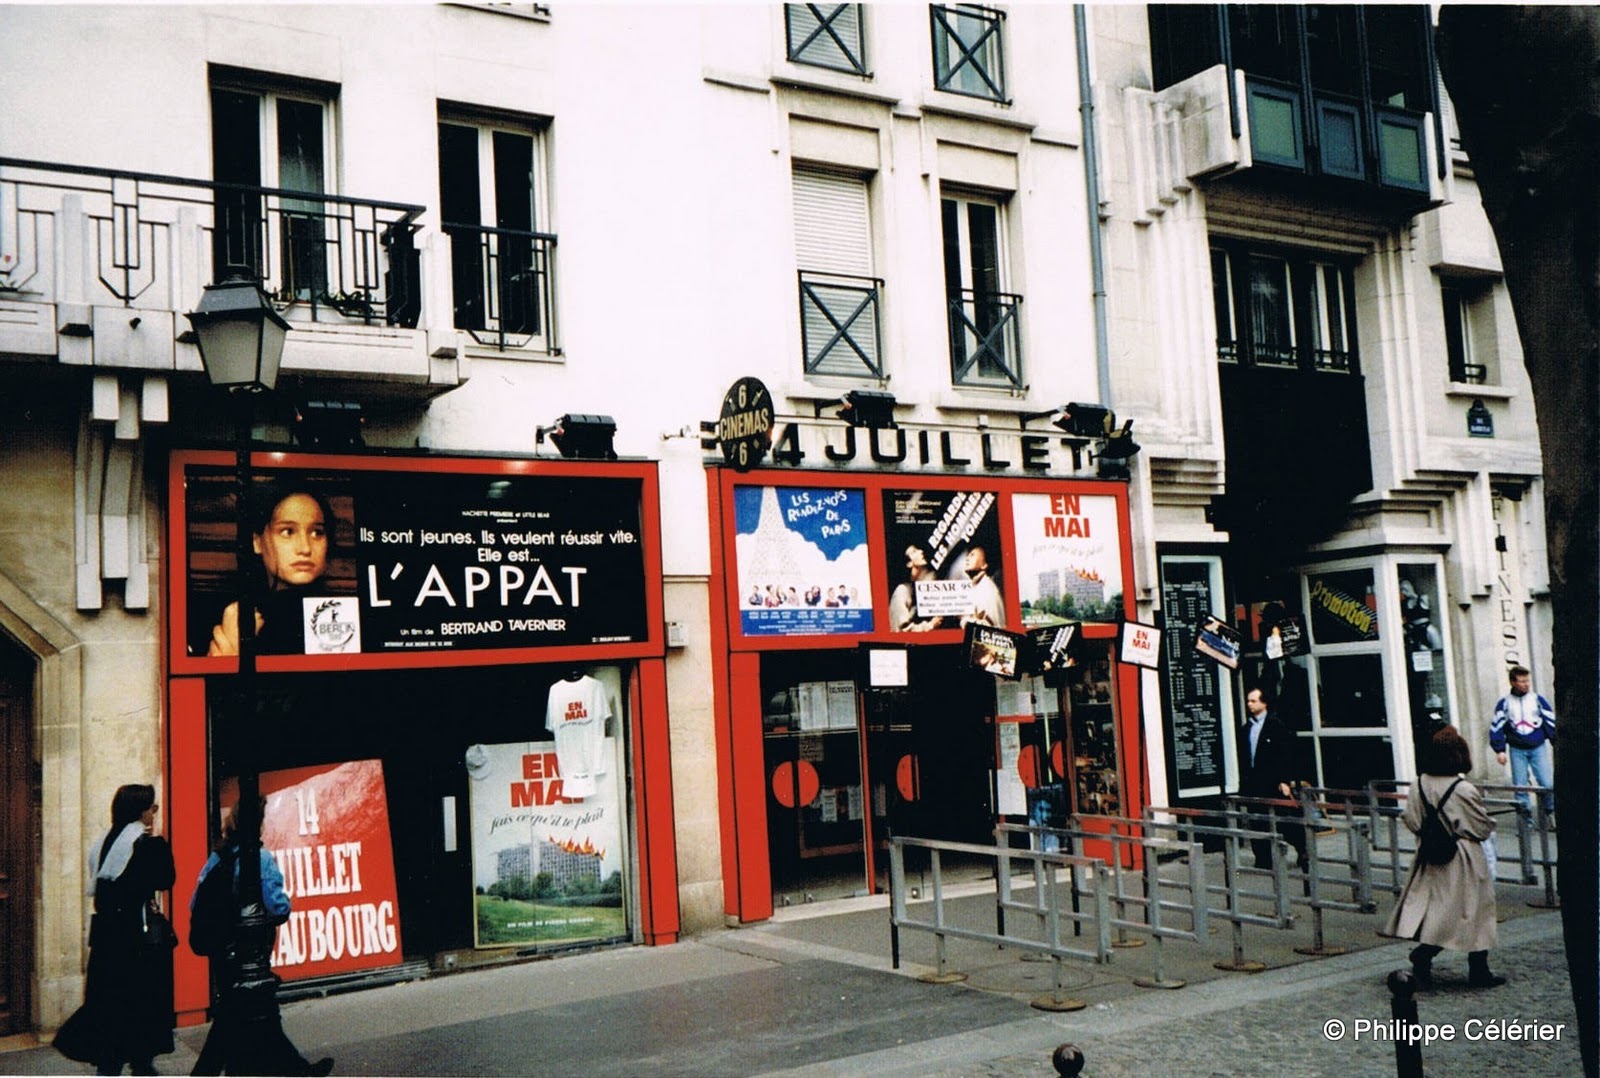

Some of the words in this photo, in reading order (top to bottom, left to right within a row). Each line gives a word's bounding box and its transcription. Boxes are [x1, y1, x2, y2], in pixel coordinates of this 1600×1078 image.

[738, 384, 747, 409] 6
[720, 407, 769, 441] CINEMAS
[739, 441, 748, 466] 6
[824, 424, 1091, 471] JUILLET
[1049, 494, 1081, 516] EN
[360, 527, 375, 543] Ils
[381, 528, 413, 544] sont
[420, 529, 476, 547] jeunes.
[481, 529, 496, 545] Ils
[501, 529, 555, 545] veulent
[560, 530, 603, 545] réussir
[609, 530, 638, 544] vite.
[821, 519, 851, 539] PARIS
[1043, 517, 1091, 538] MAI
[477, 548, 502, 563] Elle
[440, 620, 504, 636] BERTRAND
[507, 618, 567, 632] TAVERNIER
[1136, 630, 1149, 641] EN
[1132, 638, 1151, 651] MAI
[564, 709, 588, 721] MAI
[568, 701, 583, 711] EN
[510, 779, 584, 807] MA
[296, 788, 320, 835] 14
[271, 841, 362, 898] UILLET
[269, 900, 397, 968] AUBOURG
